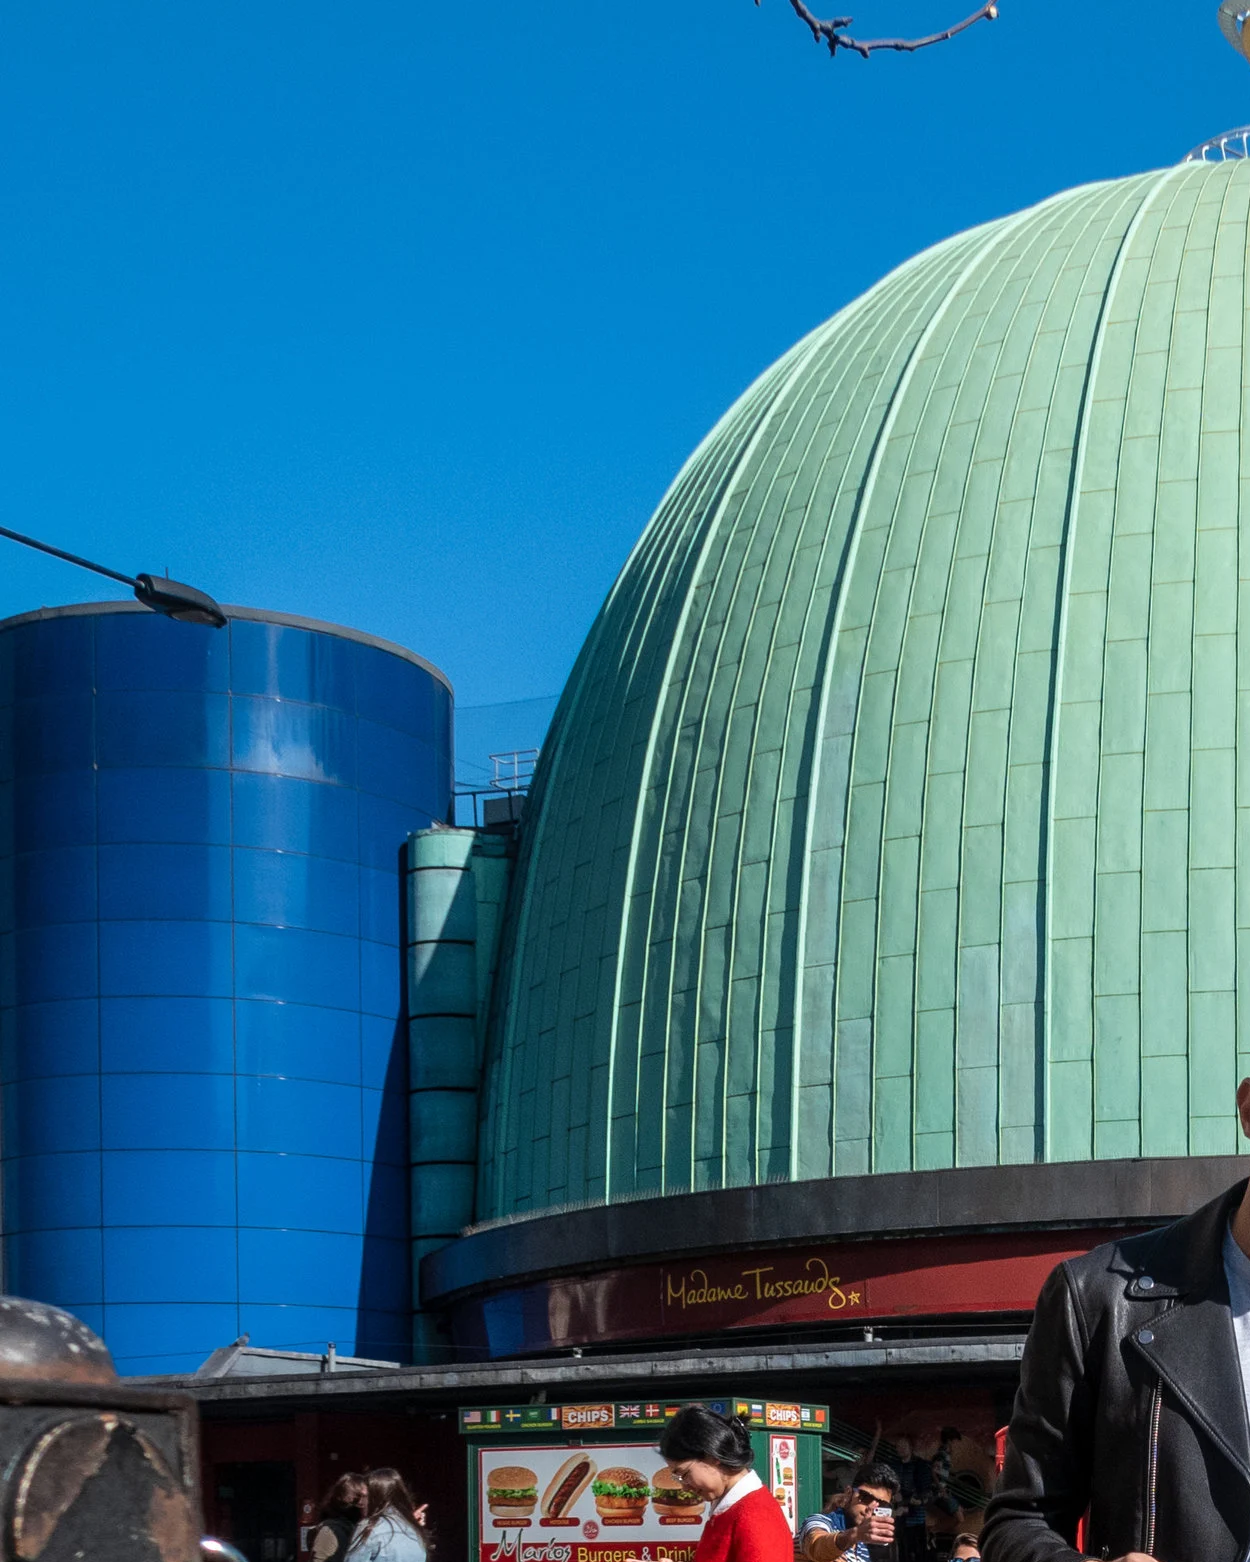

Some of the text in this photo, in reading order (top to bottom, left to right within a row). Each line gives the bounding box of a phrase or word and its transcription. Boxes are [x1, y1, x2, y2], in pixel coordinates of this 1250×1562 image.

[666, 1257, 847, 1310] Madame Tussauds
[567, 1410, 609, 1424] CHIPS
[769, 1408, 798, 1422] CHIPS
[641, 1546, 651, 1562] &
[656, 1545, 697, 1562] Drink
